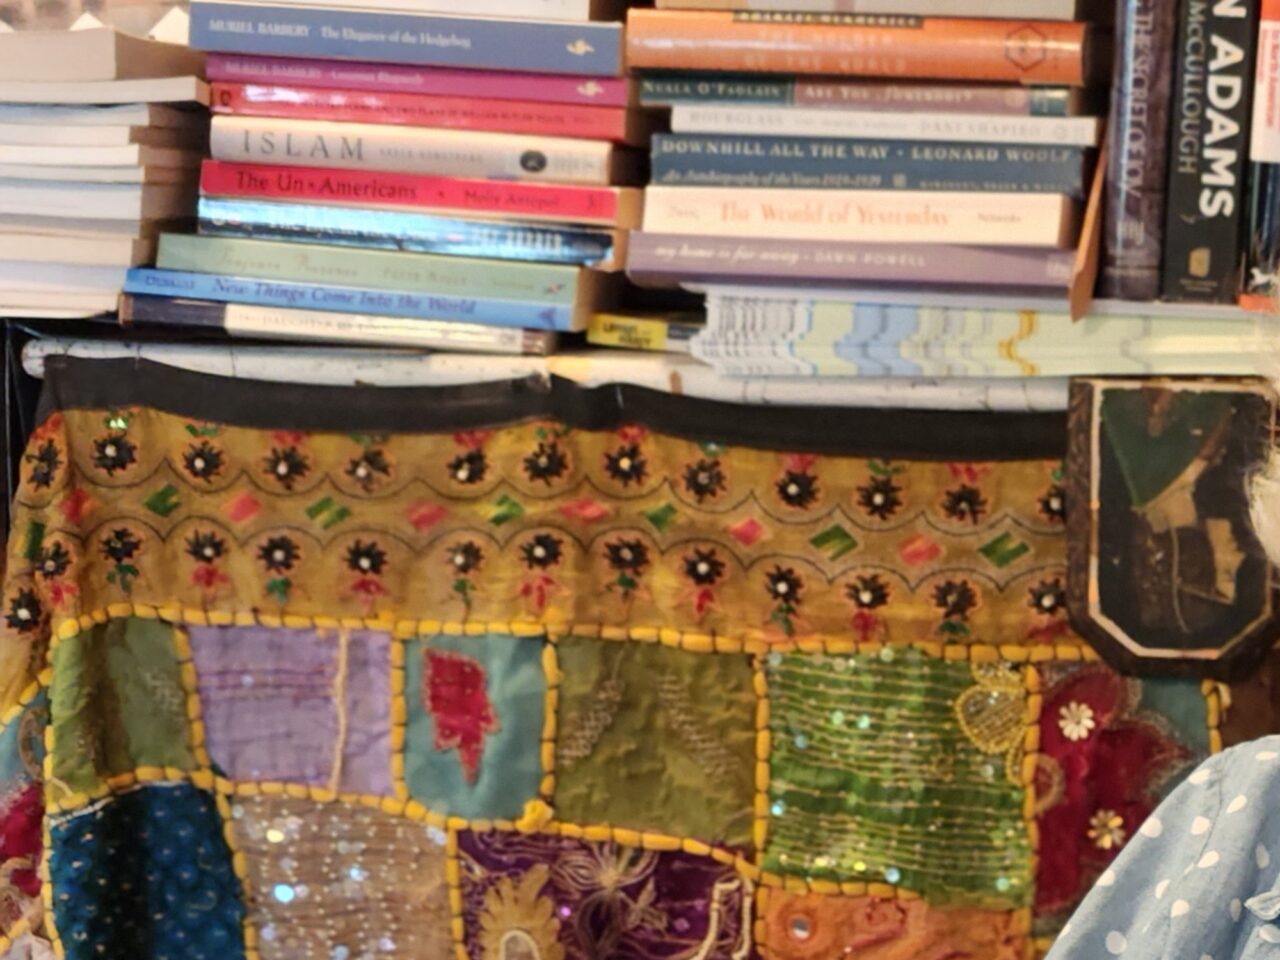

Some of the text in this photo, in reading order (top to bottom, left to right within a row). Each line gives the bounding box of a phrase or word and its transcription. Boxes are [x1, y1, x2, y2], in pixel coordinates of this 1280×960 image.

[320, 25, 340, 40] The
[641, 80, 691, 95] NUALA
[1198, 34, 1245, 218] ADAMS
[243, 129, 363, 161] ISLAM
[661, 140, 1070, 163] DOWNHILL ALL THE WAY LEONARD WOOLF
[236, 171, 269, 190] The
[720, 201, 749, 222] The
[761, 203, 823, 223] World
[828, 203, 849, 224] of
[857, 205, 949, 227] Yesterday
[863, 252, 926, 268] POWELL
[211, 278, 246, 295] New
[254, 282, 306, 304] Things
[311, 286, 353, 303] Come
[358, 291, 394, 308] Into
[398, 293, 423, 310] the
[426, 297, 477, 315] World
